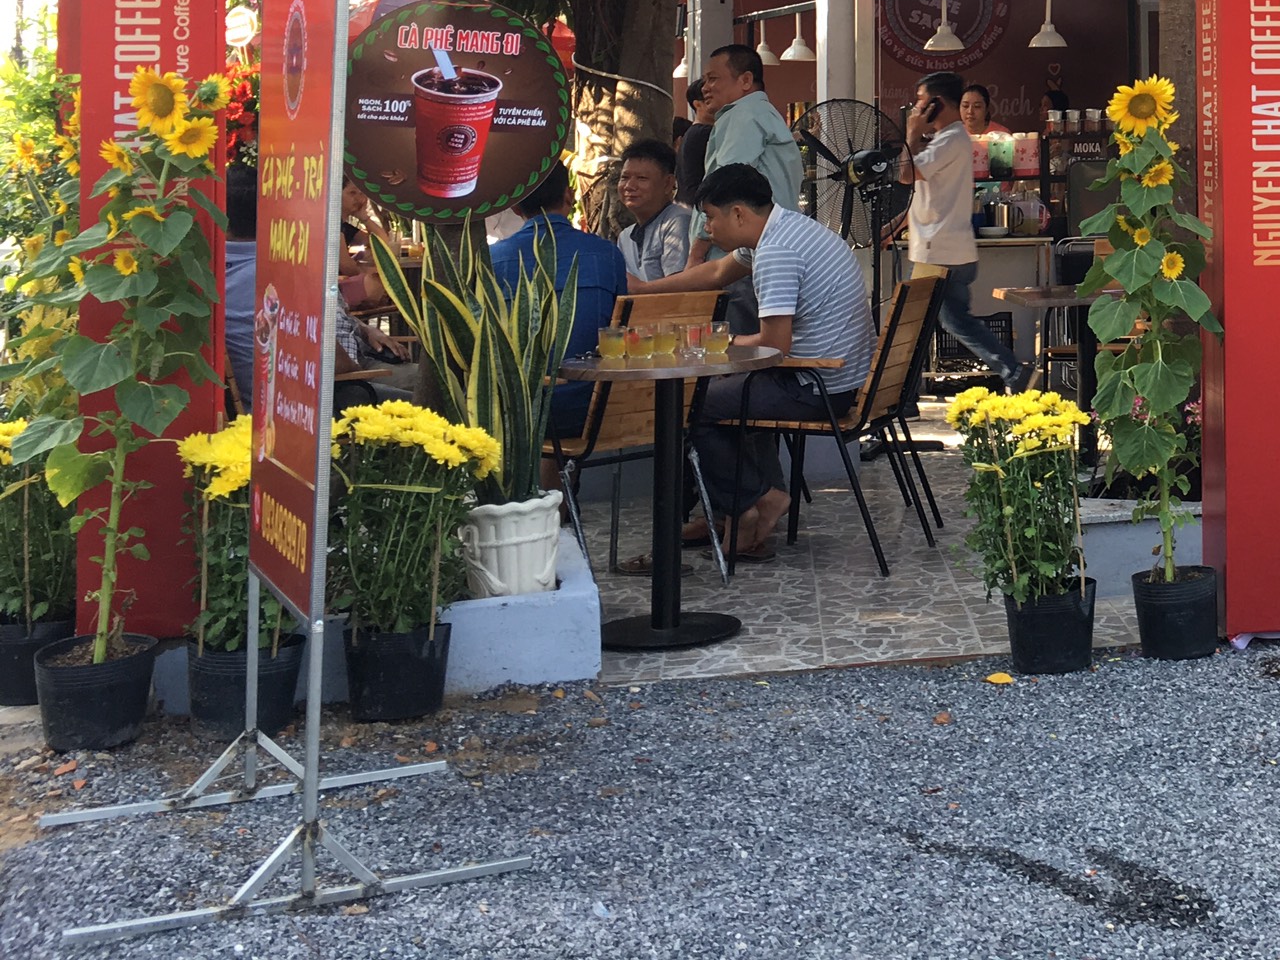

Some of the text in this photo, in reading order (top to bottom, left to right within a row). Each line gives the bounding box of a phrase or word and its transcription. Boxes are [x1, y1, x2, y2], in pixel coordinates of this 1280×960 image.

[397, 22, 520, 56] CÀ PHÊ MANG ĐI
[1074, 142, 1101, 153] MOKA
[262, 141, 324, 201] CÀ PHÊ TRÀ
[269, 217, 310, 266] MANG ĐI
